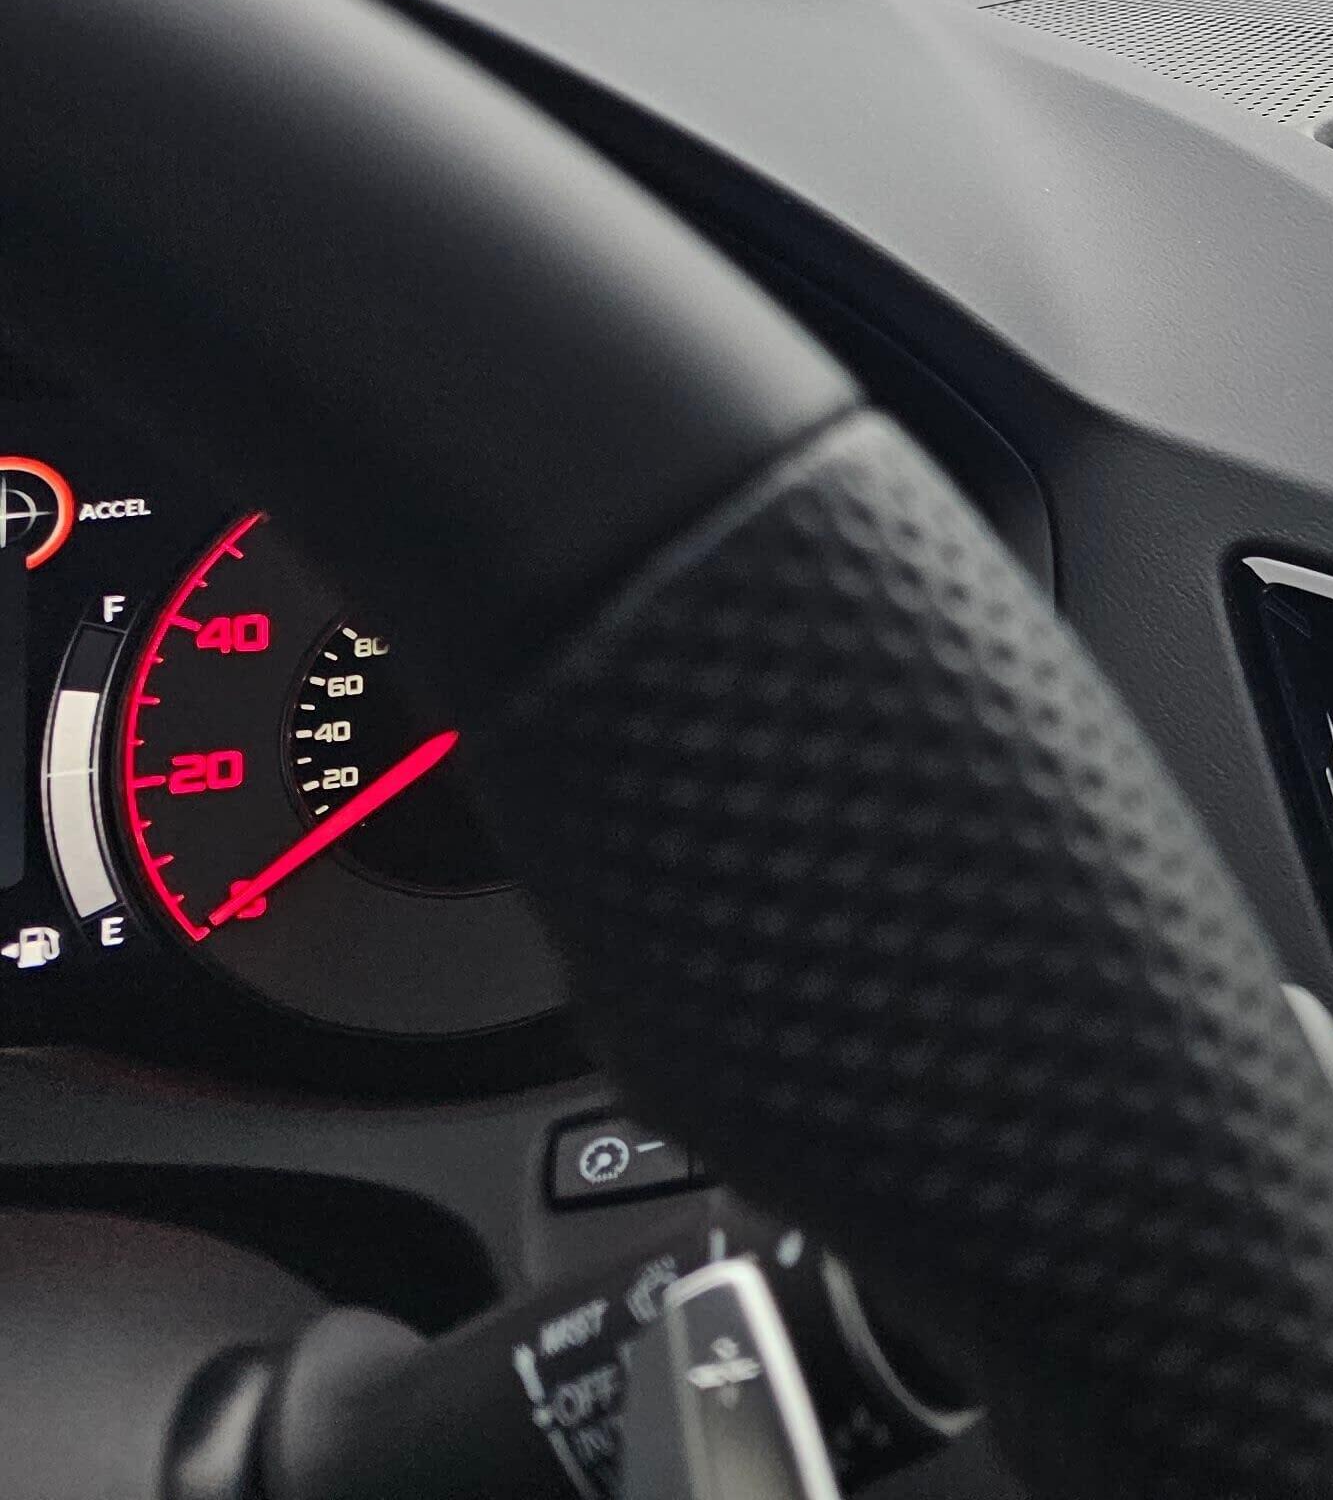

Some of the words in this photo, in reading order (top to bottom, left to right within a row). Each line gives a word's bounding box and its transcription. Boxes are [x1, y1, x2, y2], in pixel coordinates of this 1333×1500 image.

[78, 498, 152, 522] ACCEL
[103, 595, 126, 622] F
[198, 613, 270, 653] 40
[327, 674, 364, 698] 60
[313, 720, 351, 743] 40
[168, 749, 244, 794] 20
[322, 766, 359, 790] 20
[101, 917, 124, 947] E
